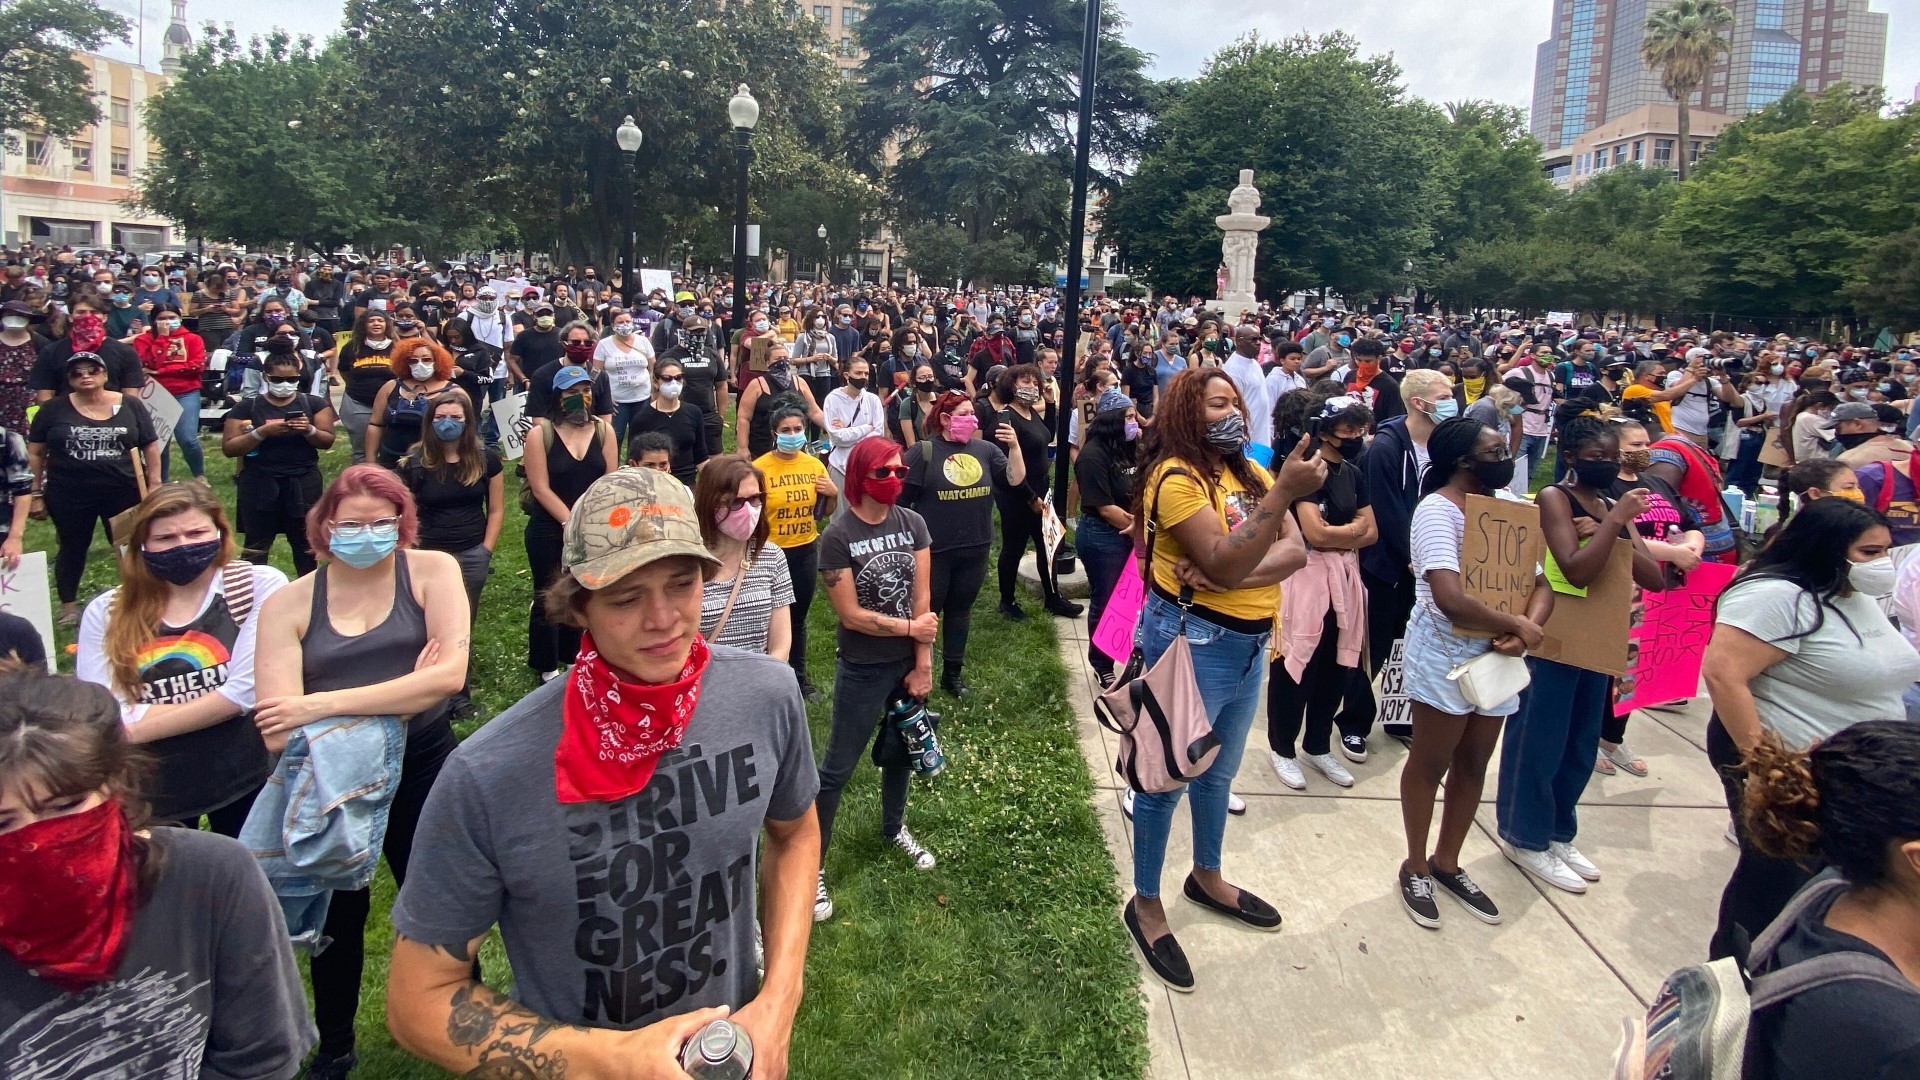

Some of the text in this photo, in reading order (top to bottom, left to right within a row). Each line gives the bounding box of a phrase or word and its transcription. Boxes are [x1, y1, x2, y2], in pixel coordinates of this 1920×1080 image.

[770, 473, 816, 488] LATINOS
[786, 489, 809, 502] FOR
[937, 486, 991, 500] WATCHMEN
[777, 505, 814, 519] BLACK
[778, 522, 811, 535] LIVES
[849, 539, 873, 557] SICK
[871, 537, 884, 552] OF
[885, 534, 897, 549] IT
[1475, 512, 1527, 567] STOP
[1466, 564, 1531, 597] KILLING
[1635, 598, 1664, 685] ATTER
[1674, 594, 1717, 663] BLACK
[576, 830, 692, 919] FOR
[575, 853, 751, 970] GREAT
[583, 931, 727, 1025] NESS.
